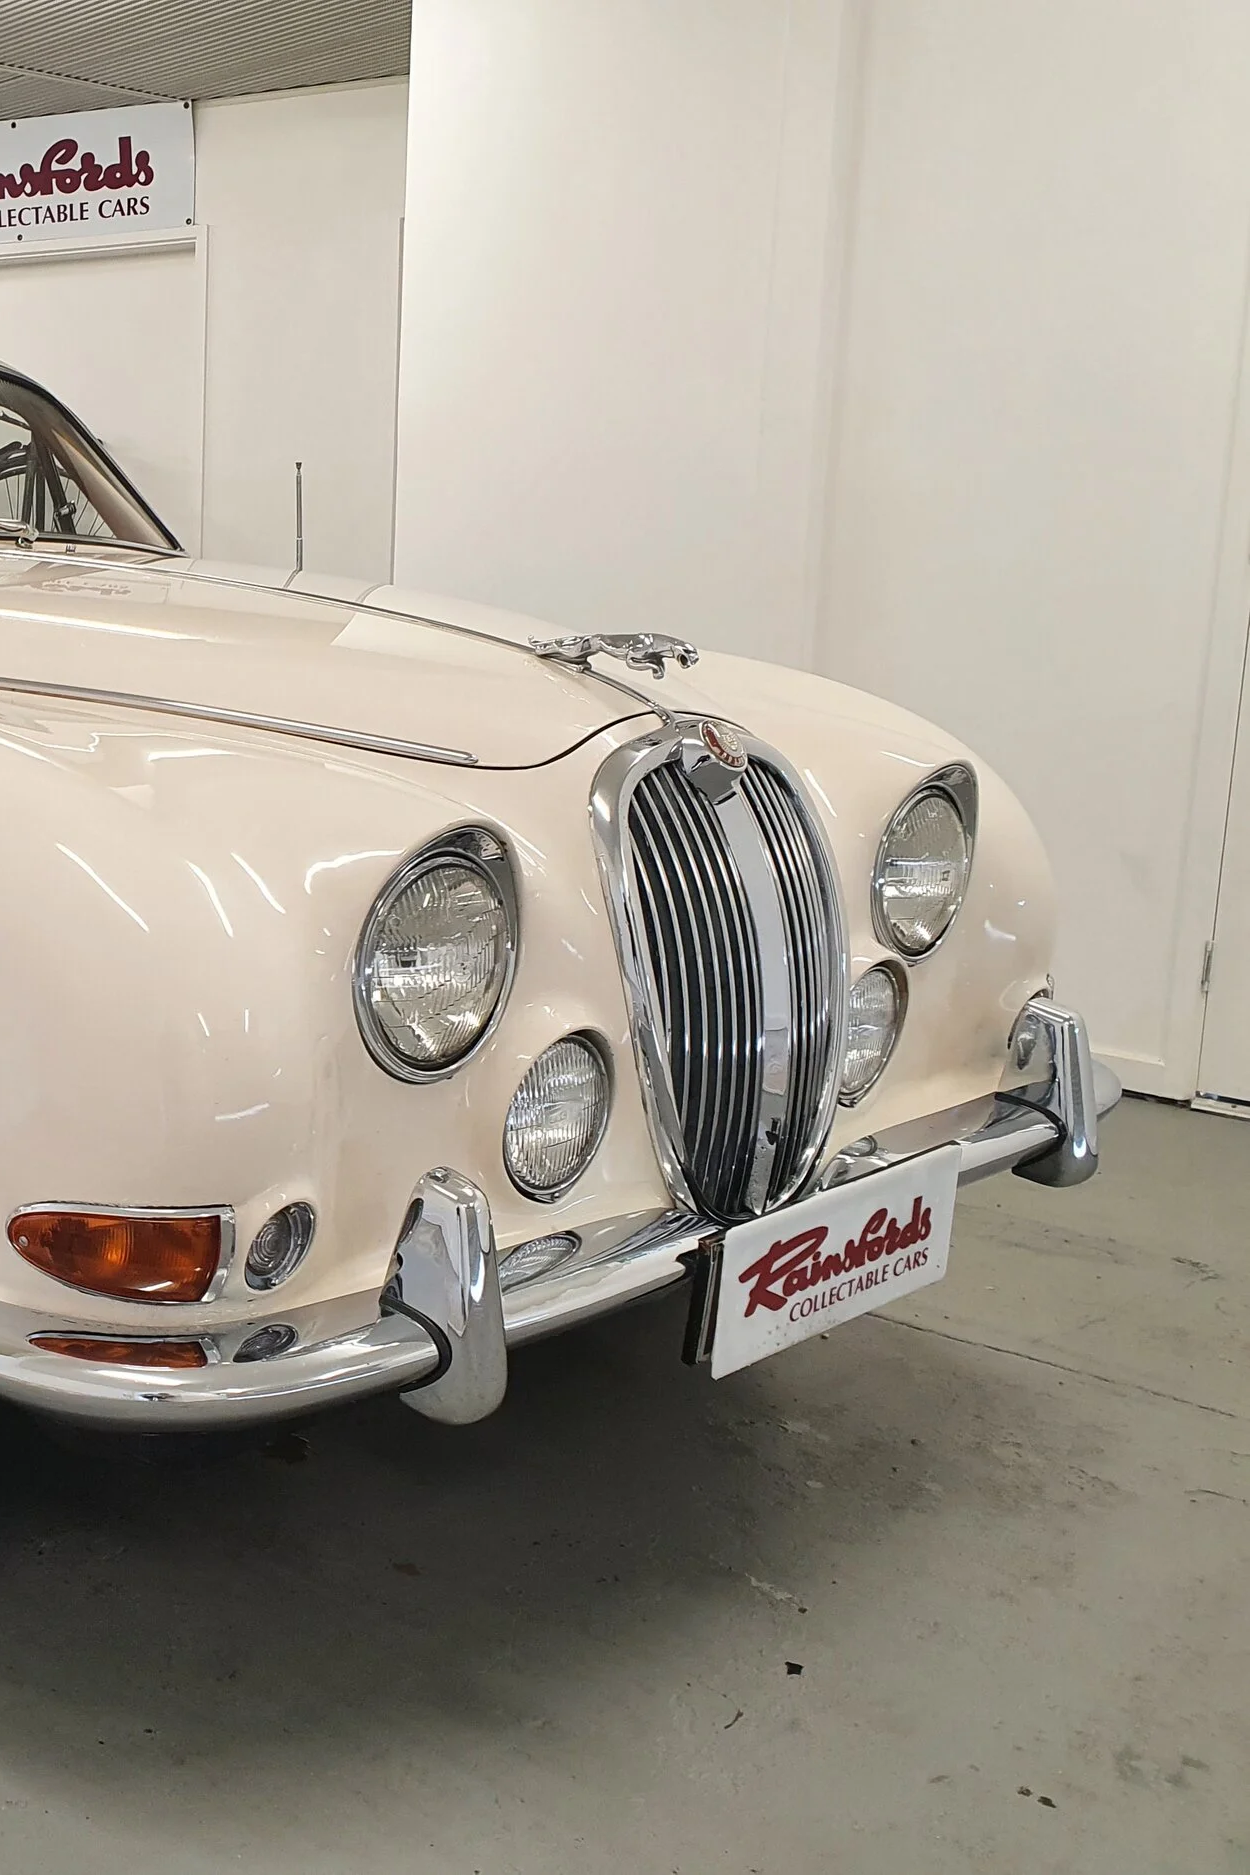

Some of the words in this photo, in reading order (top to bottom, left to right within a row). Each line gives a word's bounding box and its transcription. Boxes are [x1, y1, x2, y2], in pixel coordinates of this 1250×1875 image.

[98, 196, 151, 219] CARS
[738, 1196, 932, 1318] Rainsfords
[789, 1262, 888, 1322] COLLECTABLE
[893, 1247, 929, 1277] CARS
